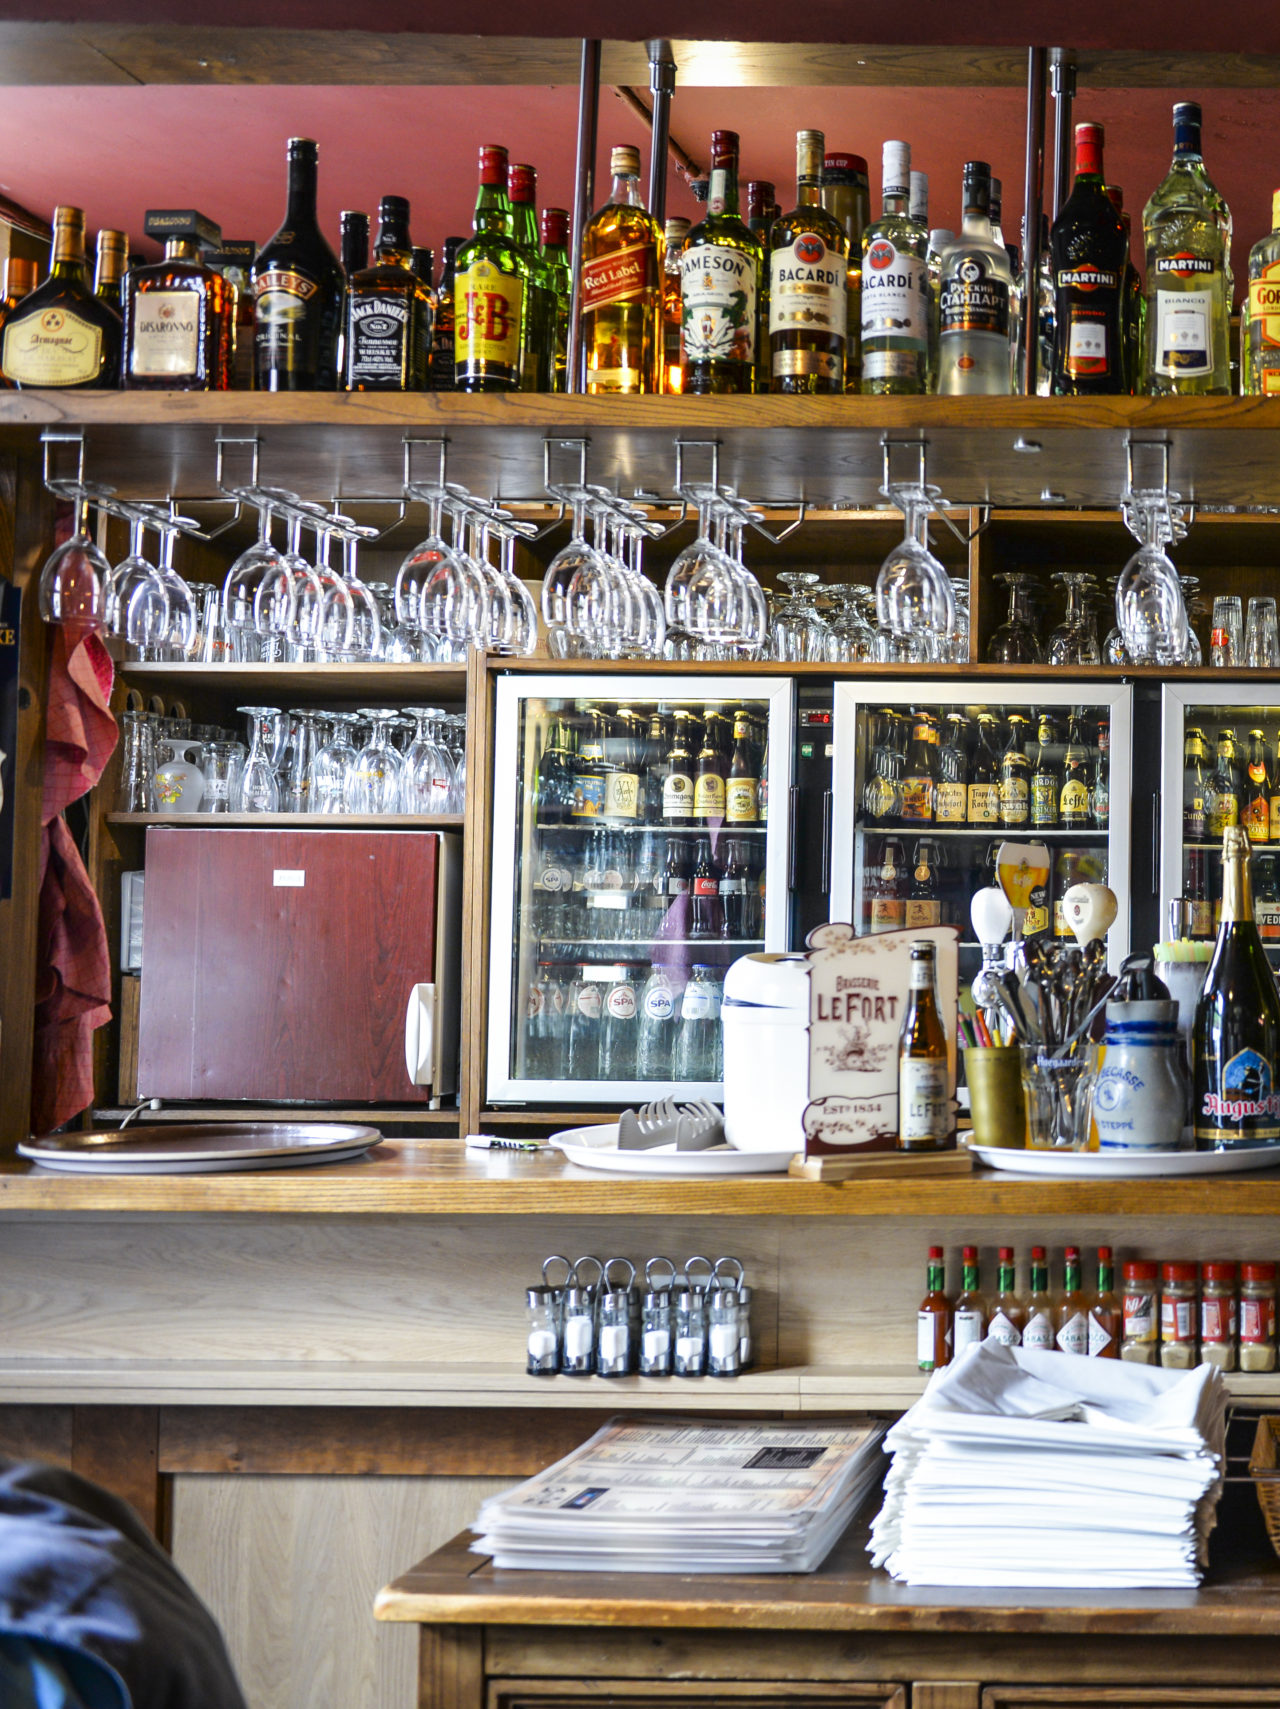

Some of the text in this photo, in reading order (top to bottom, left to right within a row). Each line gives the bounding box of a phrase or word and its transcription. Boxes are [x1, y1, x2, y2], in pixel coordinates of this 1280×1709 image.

[682, 255, 744, 278] JAMESON
[1158, 259, 1213, 272] MARTINI
[583, 272, 609, 290] Red
[608, 261, 641, 284] Label
[1061, 273, 1115, 286] MARTINI
[350, 301, 374, 322] JACK
[458, 290, 510, 342] J&B
[140, 322, 194, 334] DISARONNO
[30, 335, 73, 346] Armagnac
[1030, 891, 1046, 900] NEW
[613, 998, 634, 1007] SPA
[650, 999, 671, 1008] SPA
[853, 1103, 883, 1114] 1854
